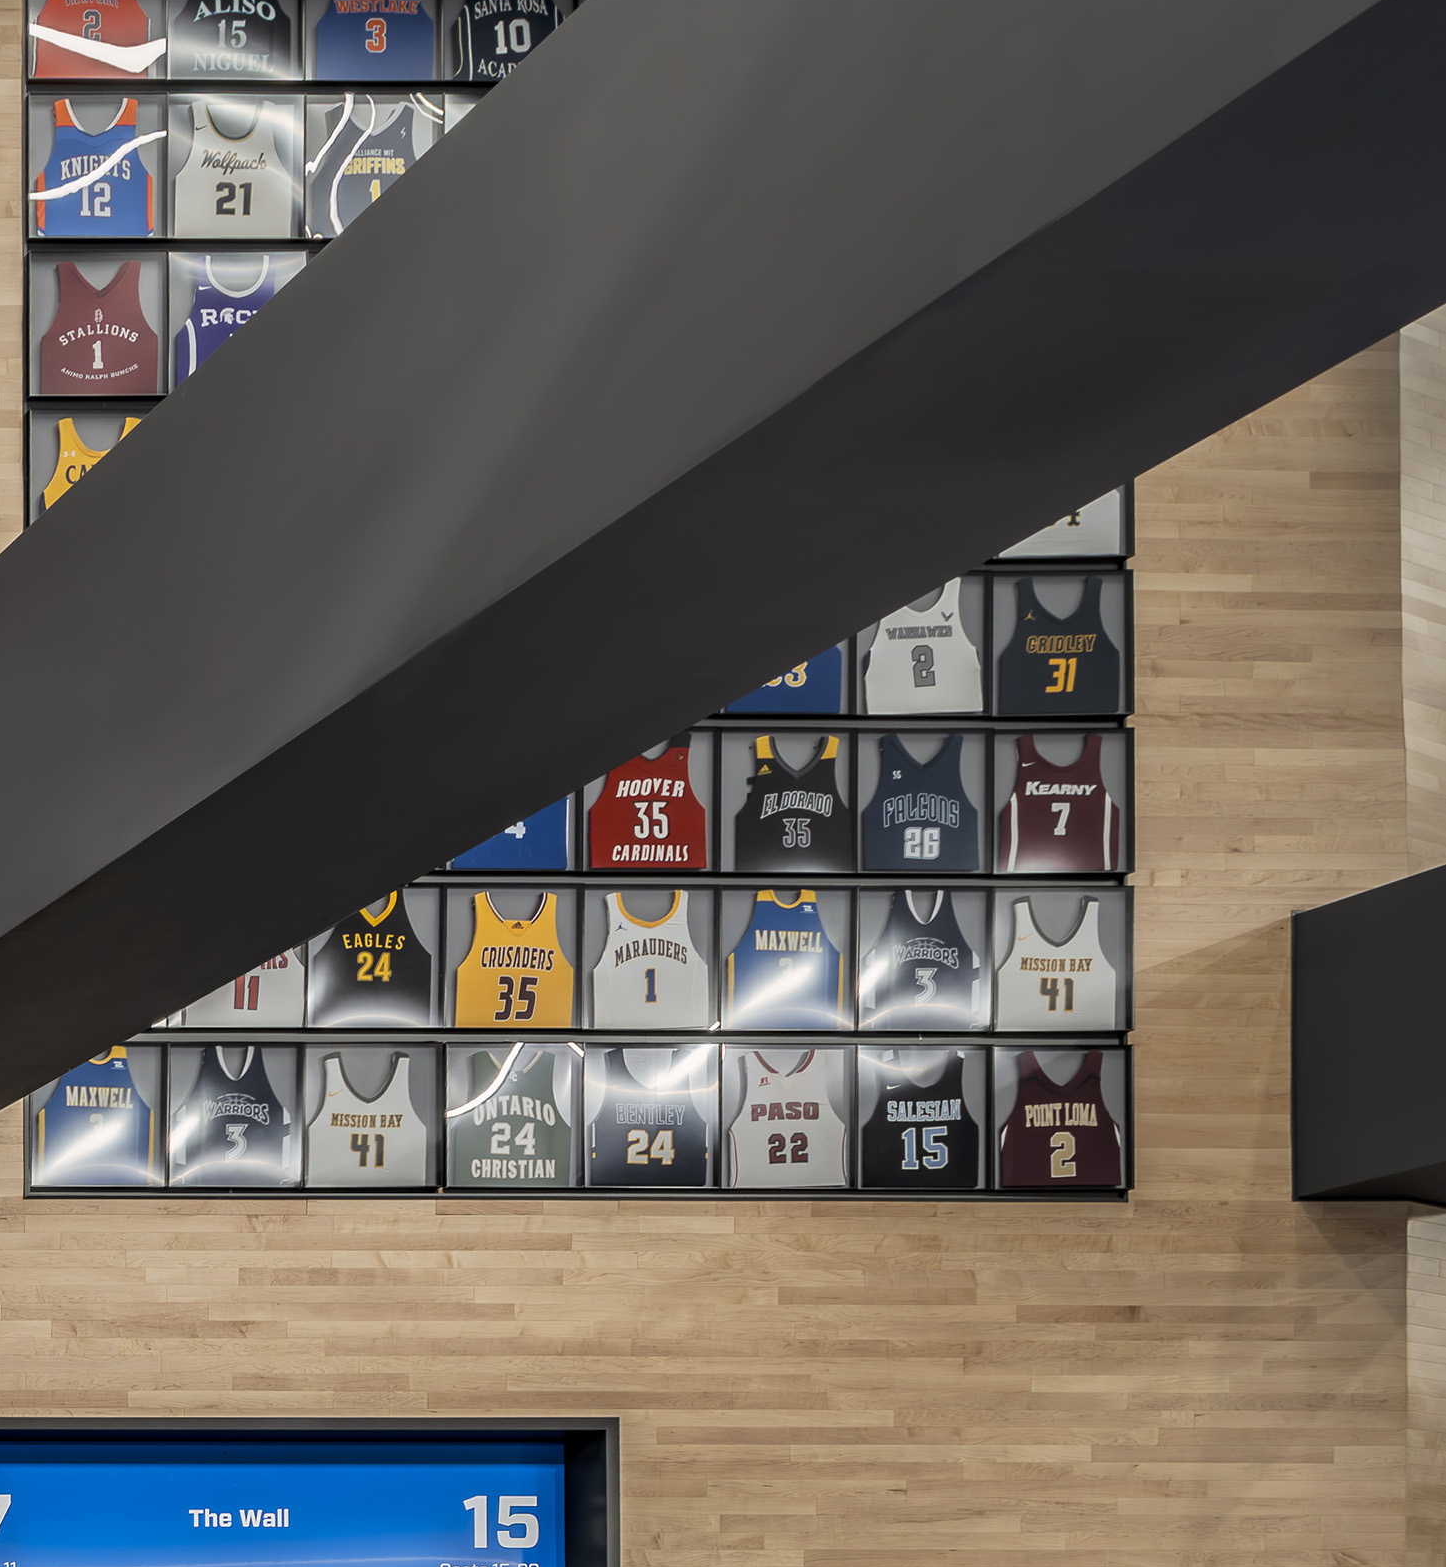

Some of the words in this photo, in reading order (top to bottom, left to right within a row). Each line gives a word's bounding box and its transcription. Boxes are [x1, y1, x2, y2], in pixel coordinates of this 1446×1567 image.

[335, 0, 420, 15] WESTLAKE
[366, 18, 386, 54] 3
[201, 150, 266, 175] Wolfpack
[59, 325, 139, 346] STALLIONS
[1026, 634, 1096, 653] GRIDLEY
[1045, 658, 1078, 693] 31
[615, 778, 685, 798] HOOVER
[760, 791, 778, 819] EL
[780, 790, 832, 817] DORADO
[883, 793, 959, 828] FALCONS
[612, 844, 688, 863] CARDINALS
[342, 933, 405, 951] EAGLES
[614, 939, 687, 966] MARAUDERS
[481, 946, 554, 971] CRUSADERS
[494, 976, 539, 1020] 35
[750, 1102, 819, 1122] PASO
[887, 1100, 960, 1121] SALESIAN
[1024, 1103, 1061, 1127] POINT
[1064, 1103, 1097, 1126] LOMA
[900, 1127, 949, 1169] 15
[471, 1160, 555, 1179] CHRISTIAN
[189, 1509, 232, 1528] The
[239, 1509, 289, 1528] Wall
[462, 1496, 539, 1549] 15
